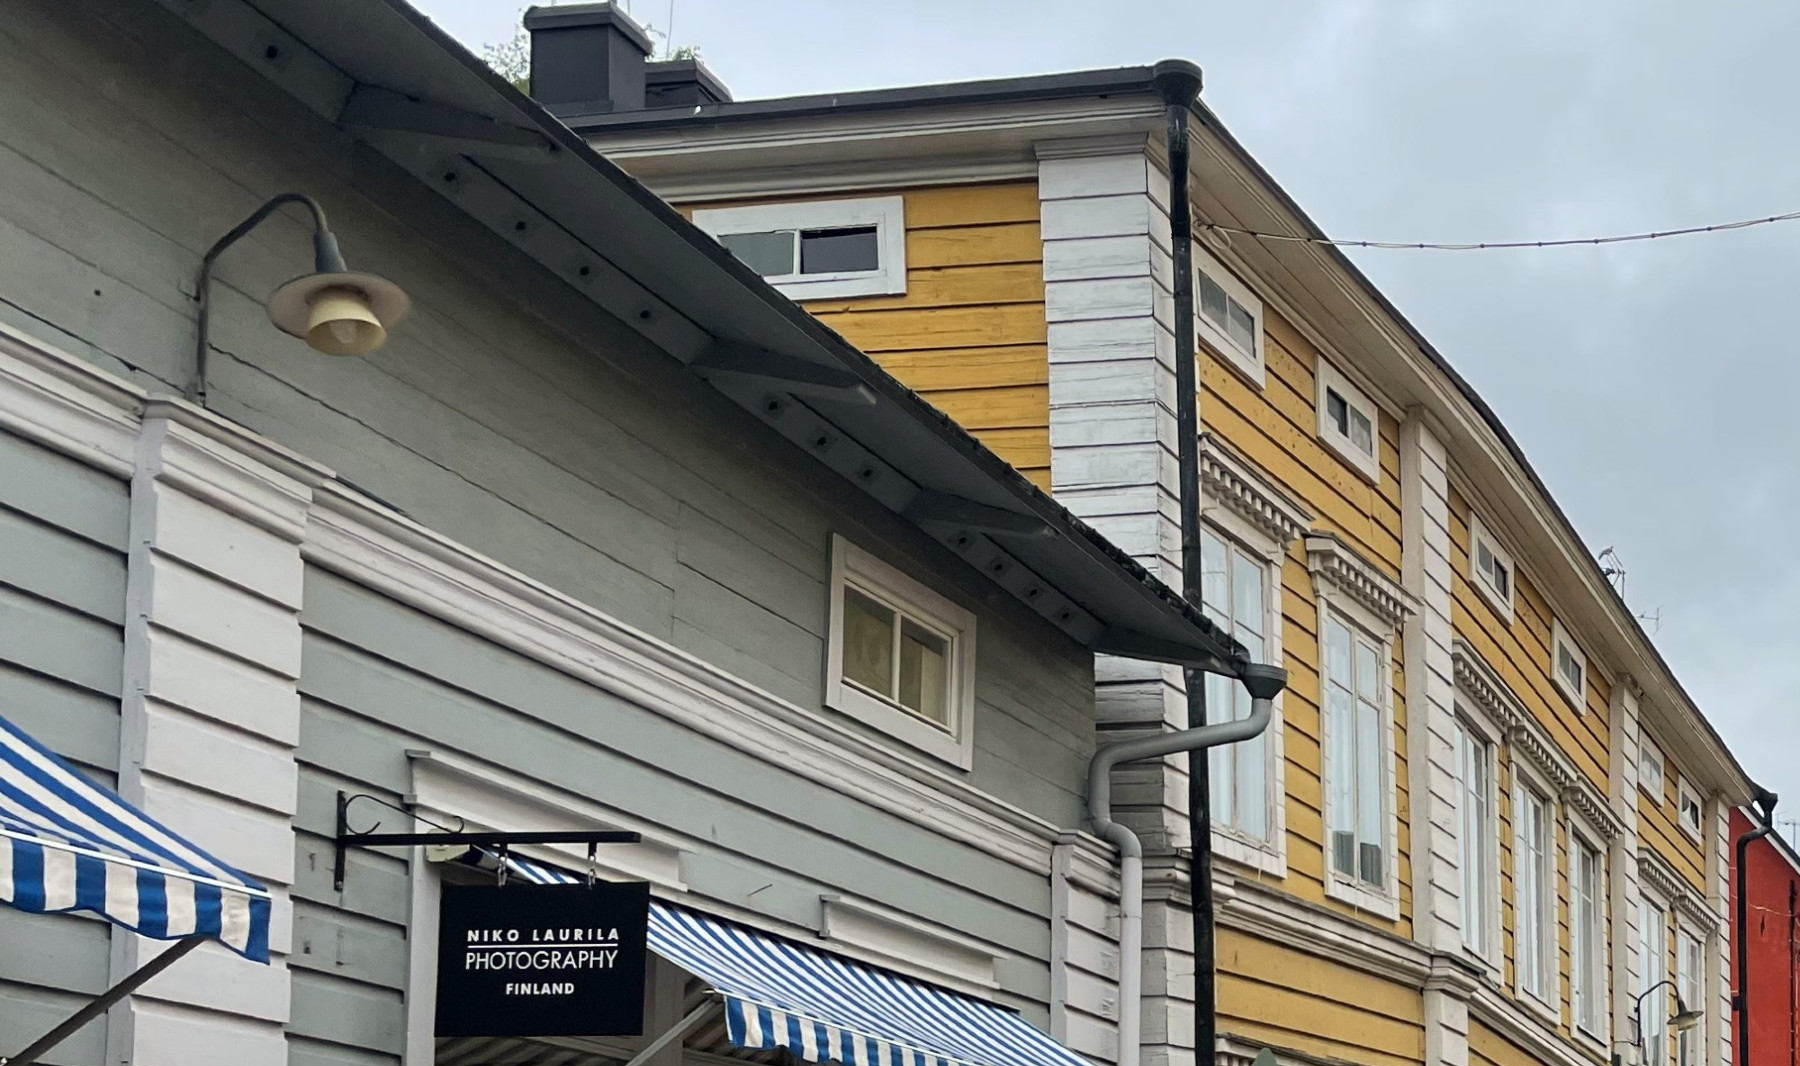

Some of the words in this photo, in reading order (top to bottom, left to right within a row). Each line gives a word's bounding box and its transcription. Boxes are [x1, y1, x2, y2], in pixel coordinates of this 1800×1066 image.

[467, 929, 519, 942] NIKO
[533, 928, 619, 941] LAURILA
[465, 950, 618, 970] PHOTOGRAPHY
[506, 983, 575, 995] FINLAND
